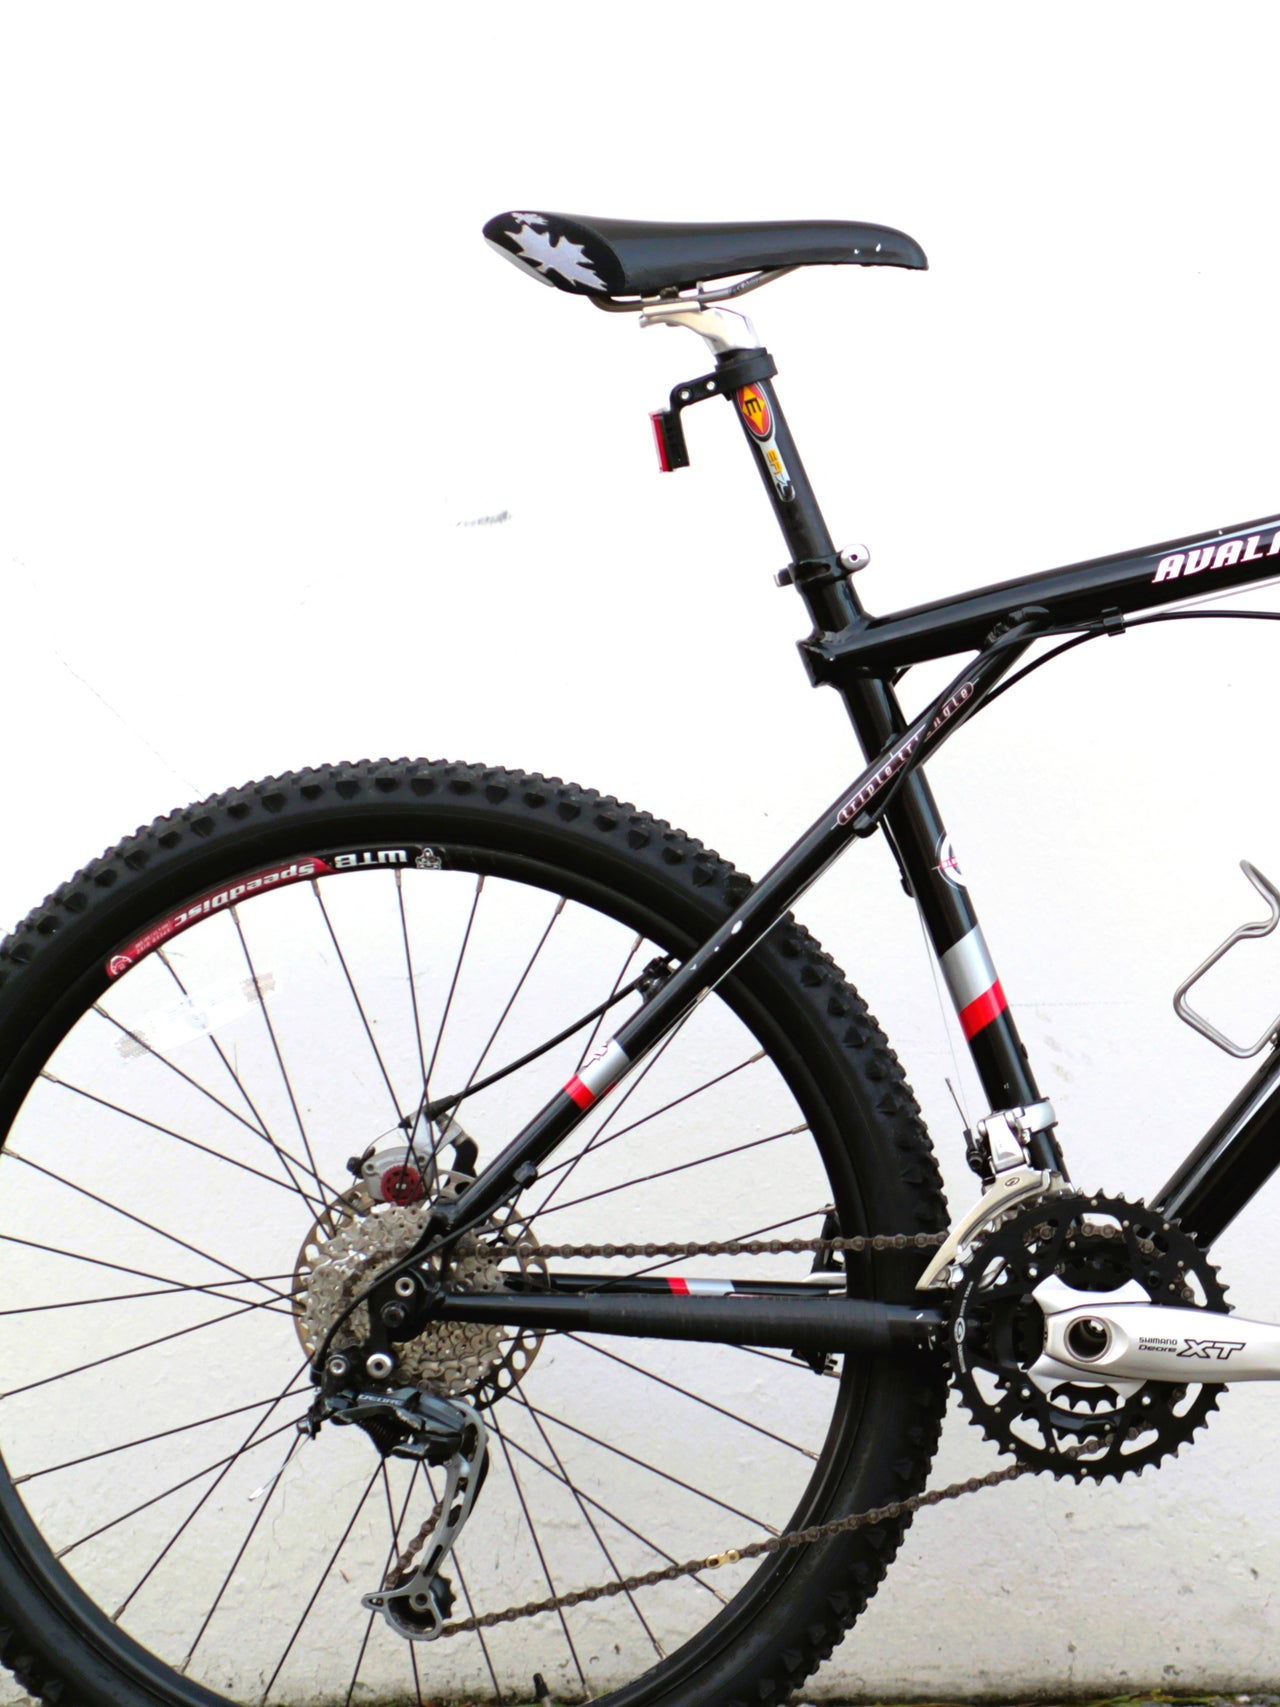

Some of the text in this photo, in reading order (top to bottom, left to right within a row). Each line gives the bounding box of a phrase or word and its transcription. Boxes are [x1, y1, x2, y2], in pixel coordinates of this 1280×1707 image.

[842, 688, 968, 819] triple trngle
[334, 850, 408, 869] WTB
[1138, 1336, 1178, 1346] SHIMANO
[1176, 1338, 1247, 1361] XT
